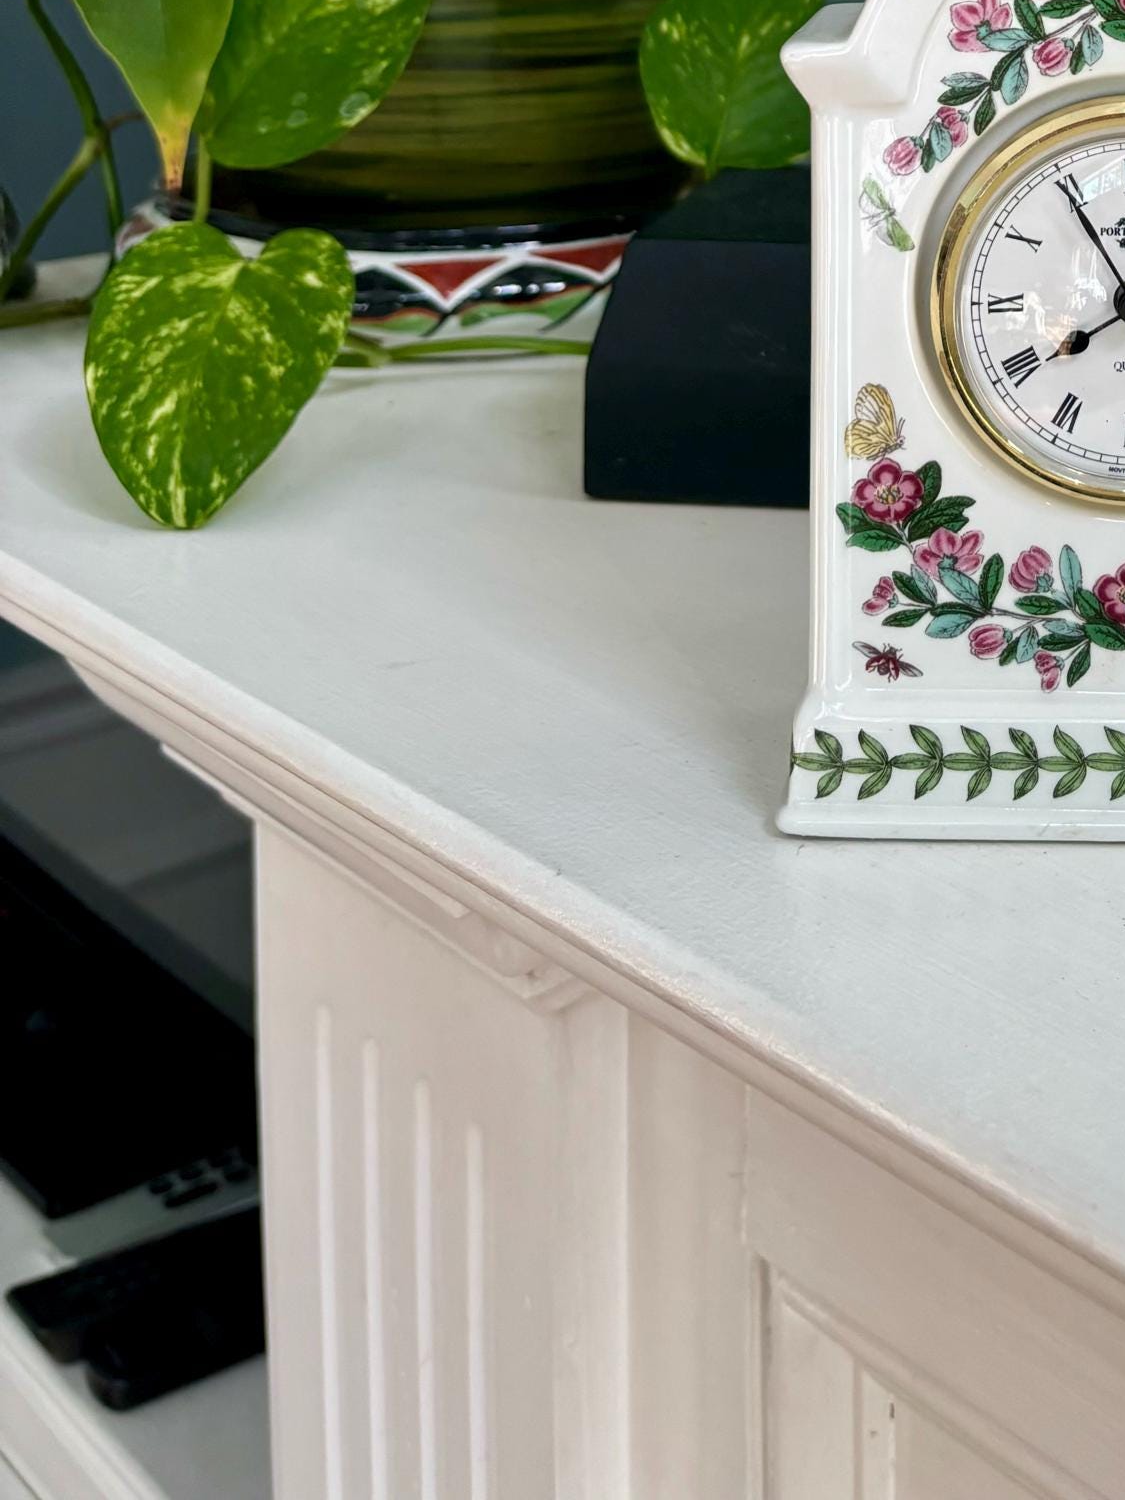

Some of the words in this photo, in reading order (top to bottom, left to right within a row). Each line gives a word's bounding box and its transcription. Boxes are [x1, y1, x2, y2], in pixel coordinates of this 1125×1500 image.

[1005, 225, 1043, 252] X
[987, 293, 1025, 314] IX
[1001, 345, 1041, 388] VIII
[1051, 392, 1084, 434] VII
